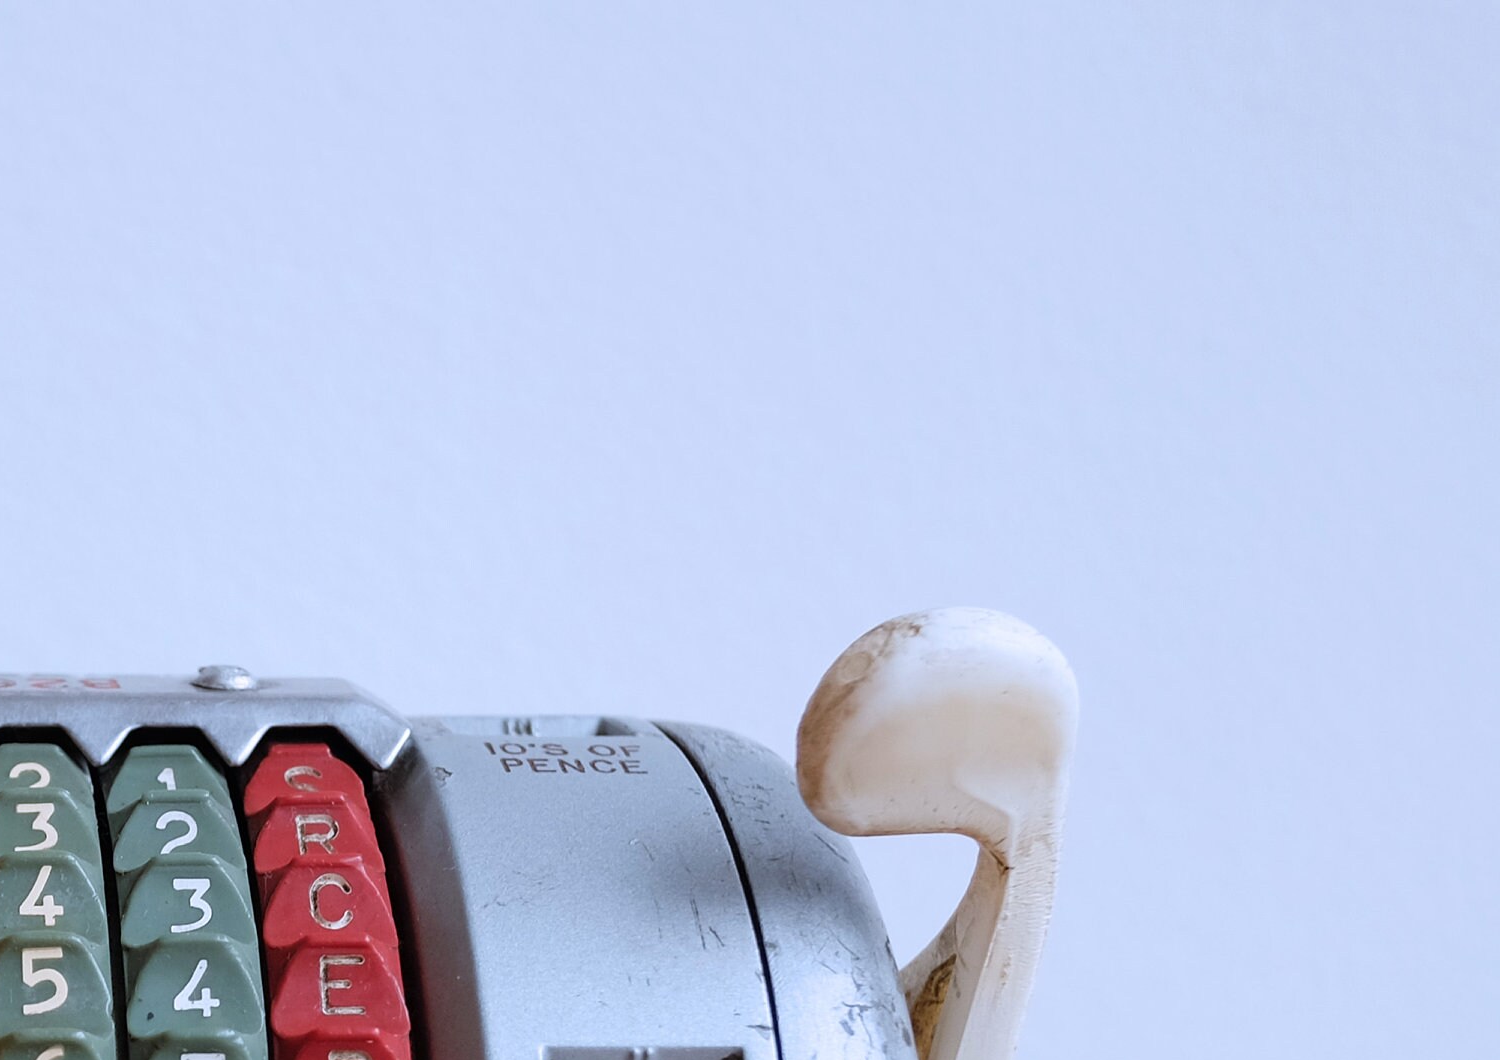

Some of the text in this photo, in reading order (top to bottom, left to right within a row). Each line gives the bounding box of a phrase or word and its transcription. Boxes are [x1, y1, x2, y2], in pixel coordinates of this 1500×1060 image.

[500, 758, 647, 774] PENCE
[587, 744, 640, 757] OF
[158, 768, 176, 790] 1
[14, 803, 58, 852] 3
[156, 811, 197, 854] 2
[295, 815, 339, 856] R
[19, 865, 64, 926] 4
[170, 878, 212, 933] 3
[308, 873, 353, 930] C
[21, 947, 68, 1016] 5
[173, 959, 220, 1017] 4
[319, 954, 366, 1016] E
